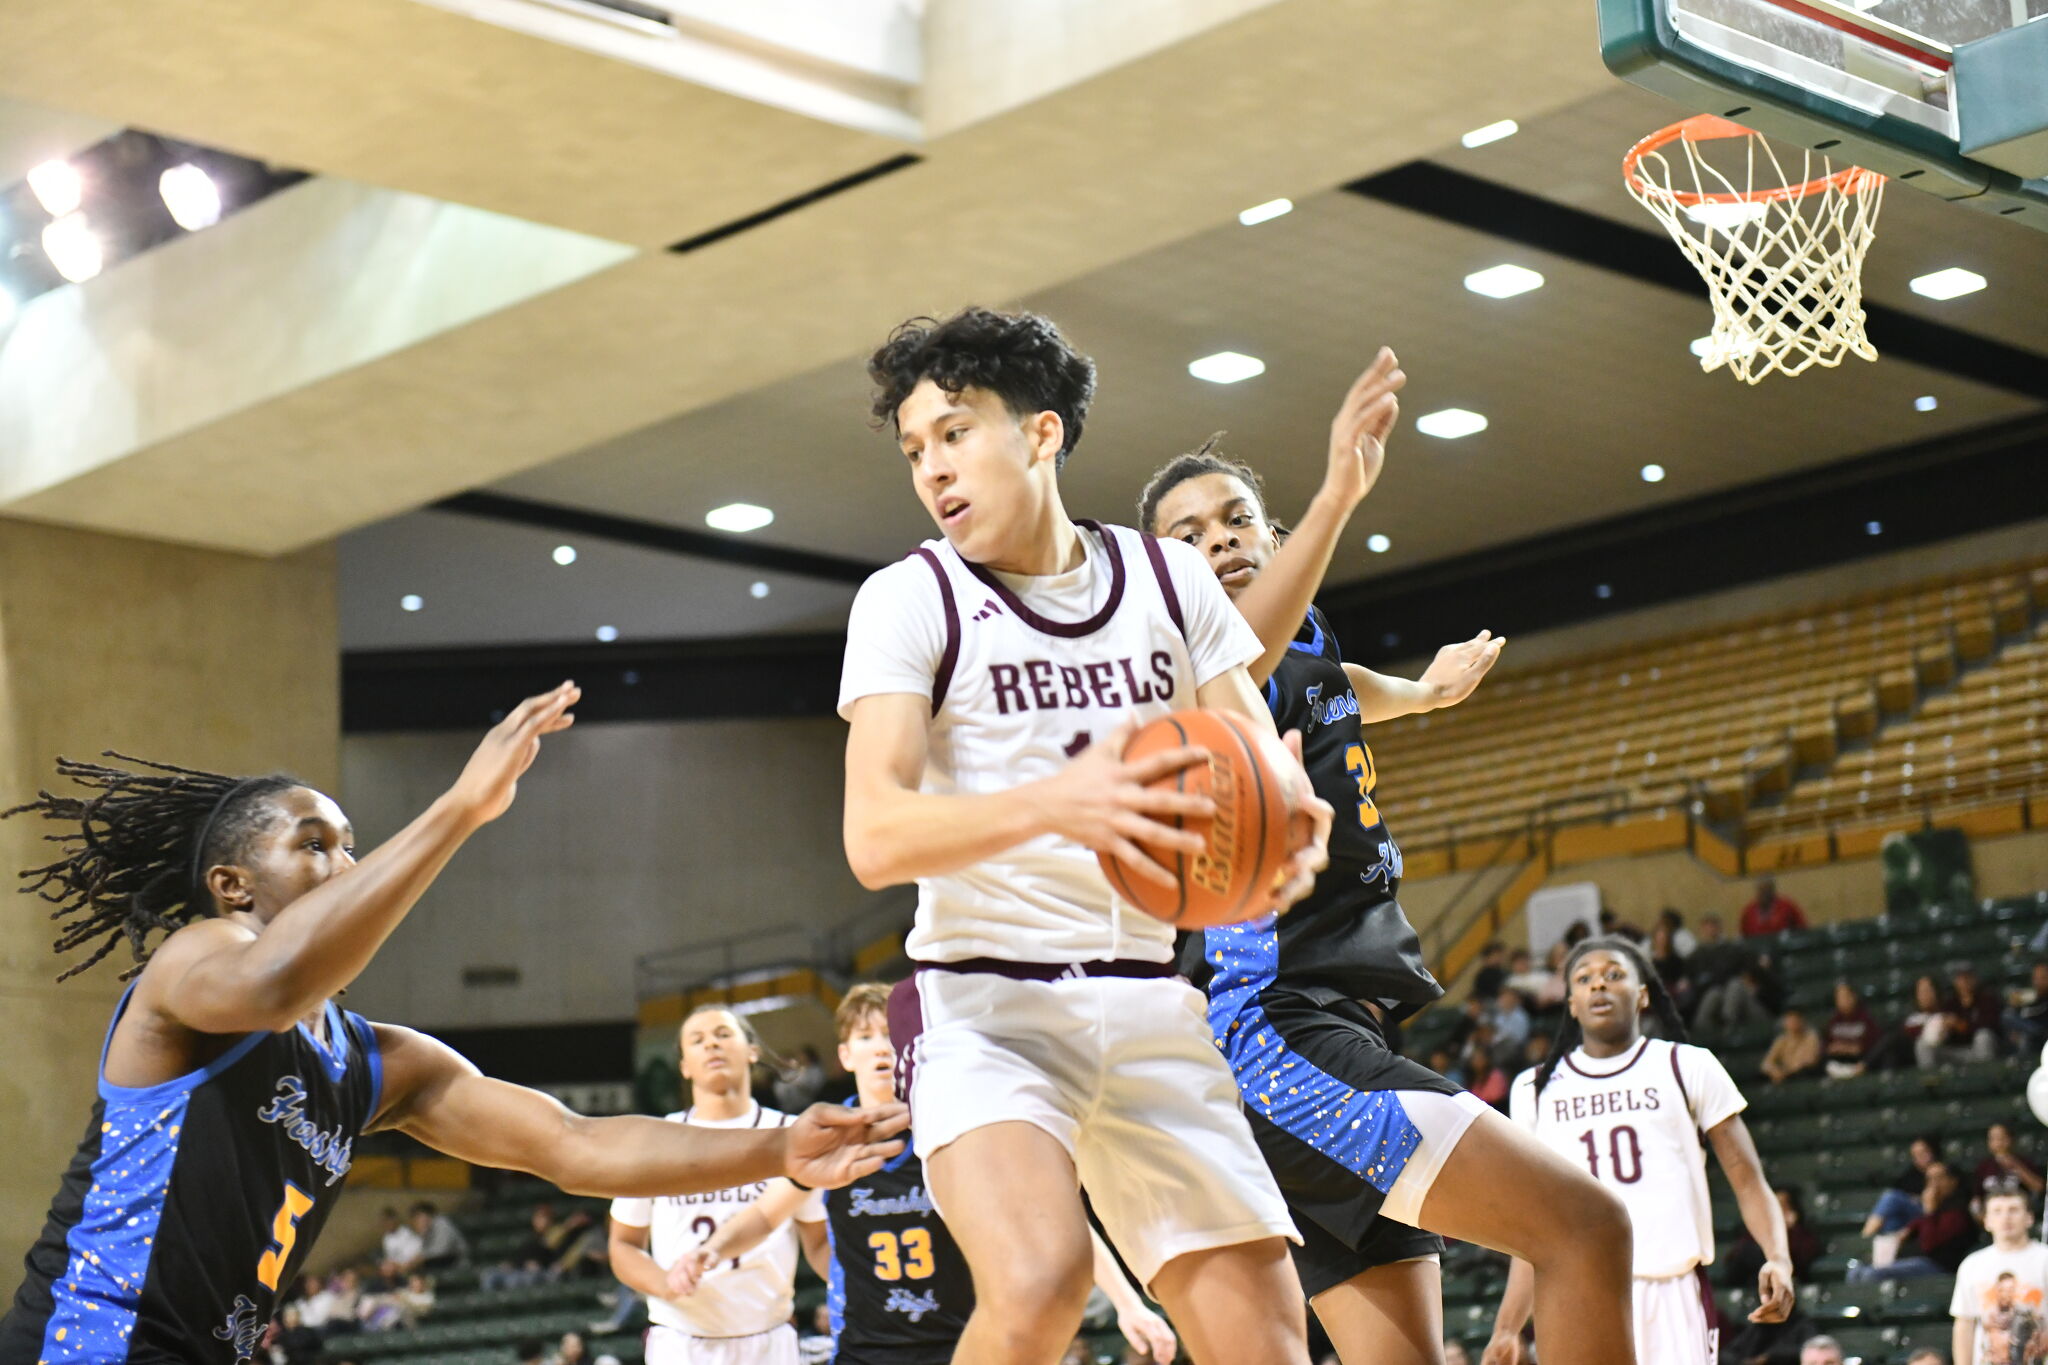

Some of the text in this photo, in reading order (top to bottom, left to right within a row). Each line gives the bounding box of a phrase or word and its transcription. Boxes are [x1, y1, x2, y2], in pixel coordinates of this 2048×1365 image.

[988, 650, 1175, 715] REBELS
[1553, 1087, 1661, 1122] REBELS
[1578, 1124, 1643, 1184] 10
[257, 1178, 316, 1294] 5
[867, 1226, 936, 1281] 33
